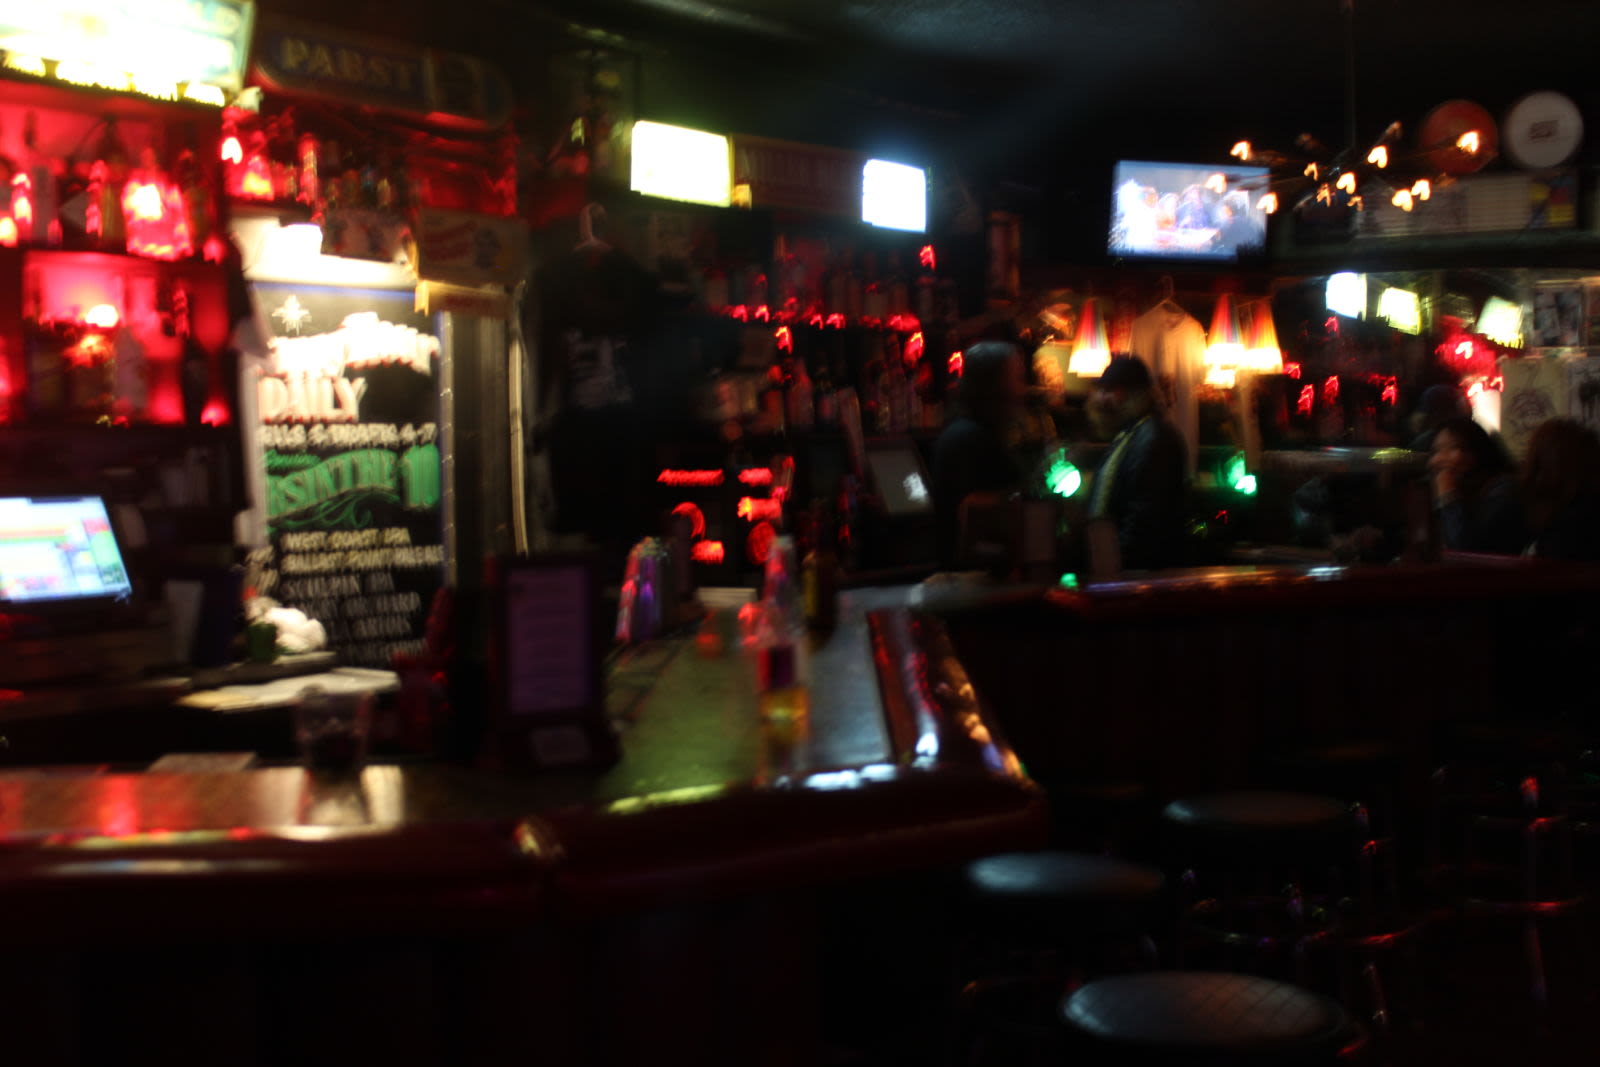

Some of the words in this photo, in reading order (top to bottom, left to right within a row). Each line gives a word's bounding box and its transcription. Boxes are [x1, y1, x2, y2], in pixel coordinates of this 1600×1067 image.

[282, 38, 415, 91] PABST
[257, 376, 368, 423] DAILY
[265, 448, 399, 516] BSINTHE
